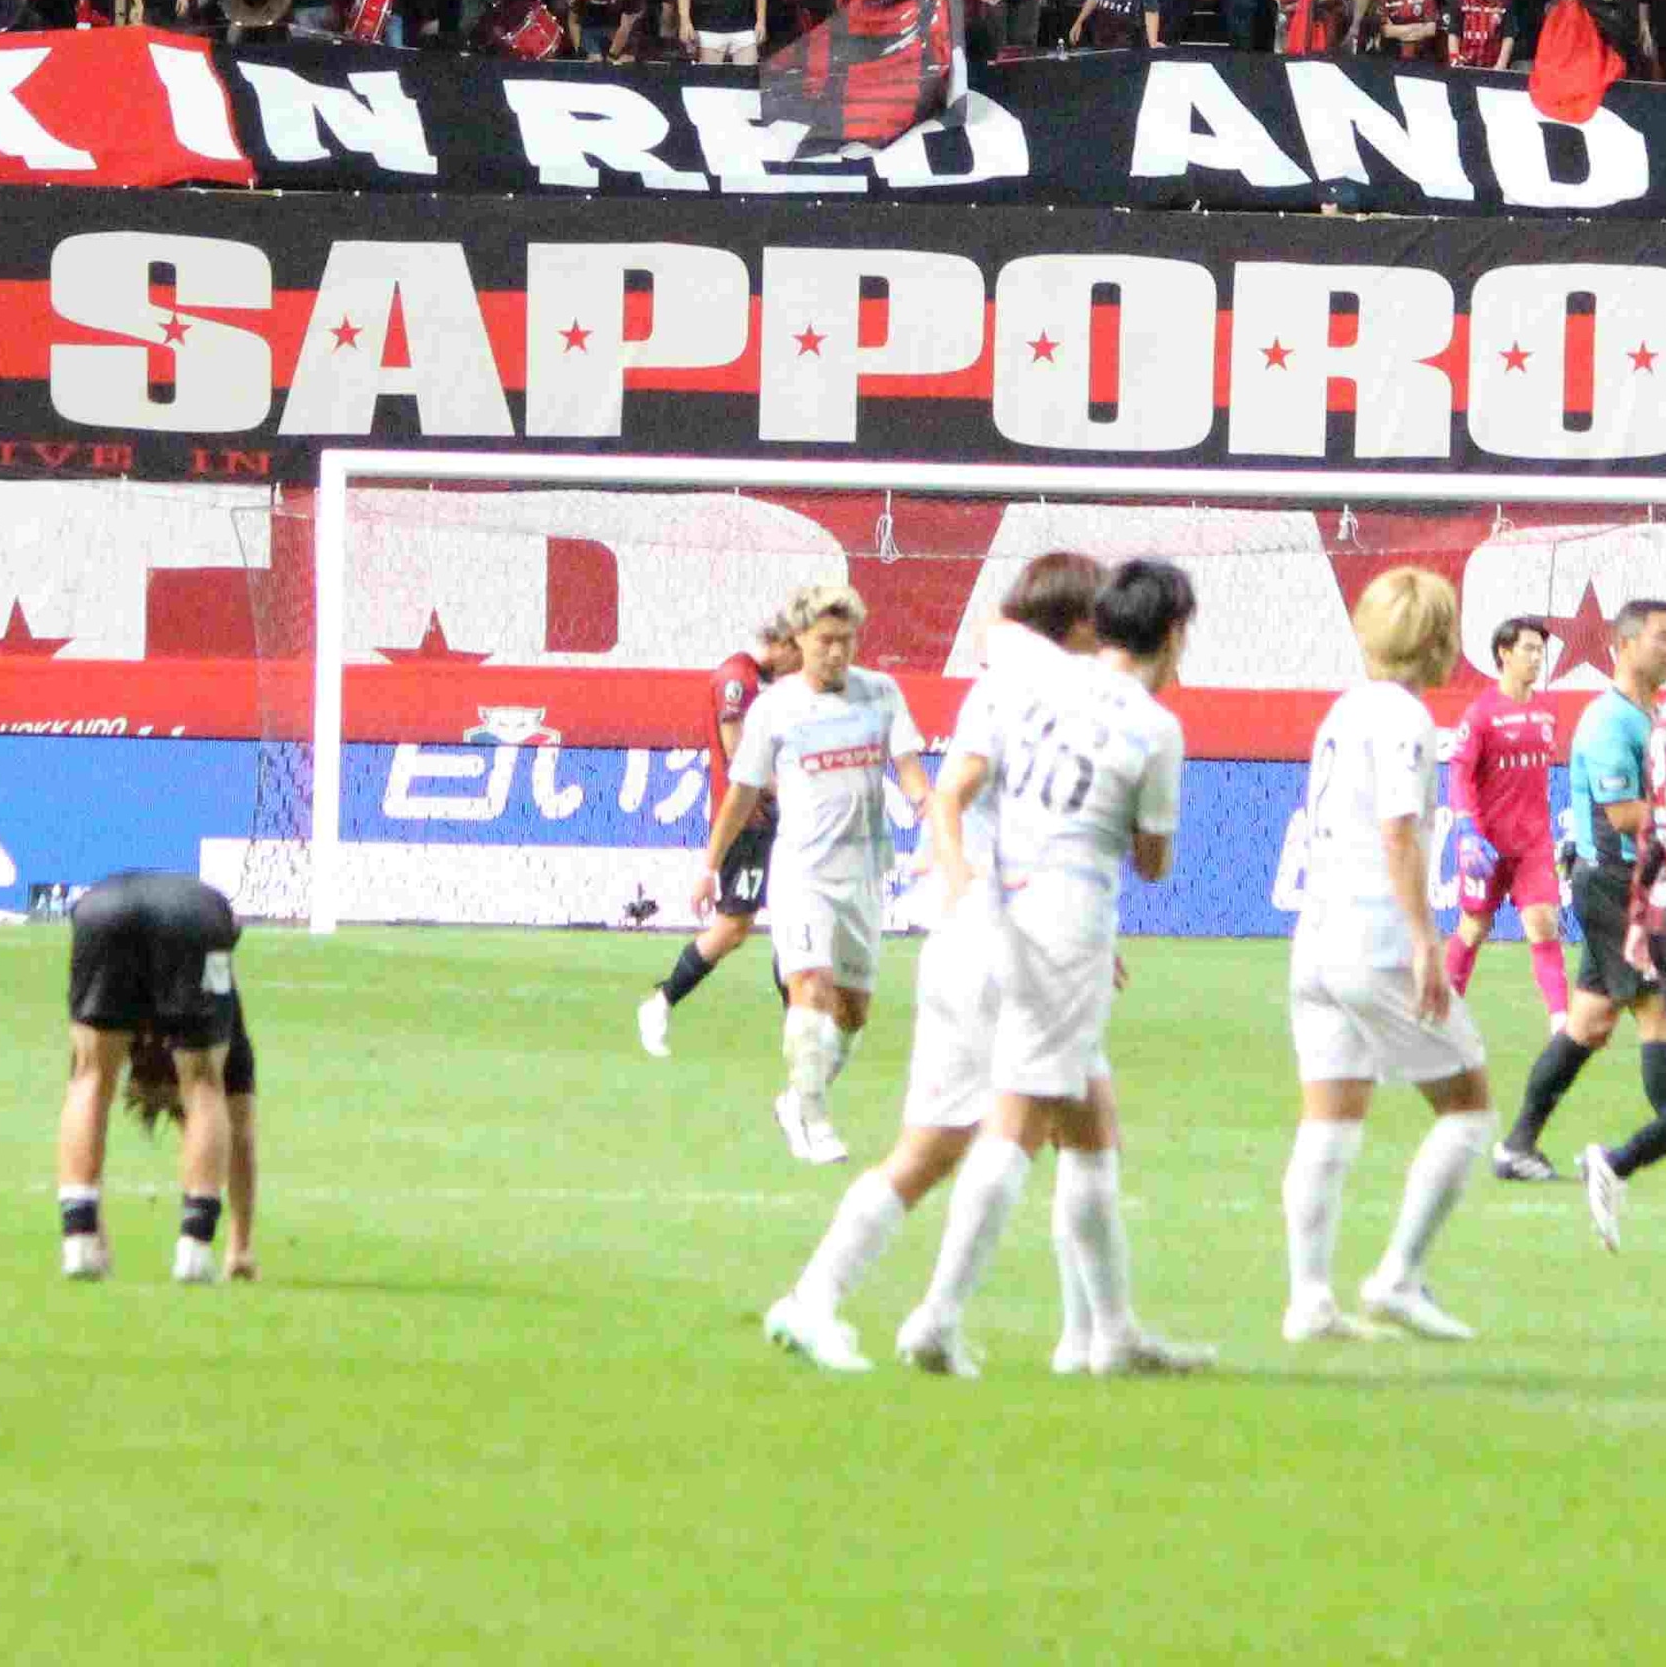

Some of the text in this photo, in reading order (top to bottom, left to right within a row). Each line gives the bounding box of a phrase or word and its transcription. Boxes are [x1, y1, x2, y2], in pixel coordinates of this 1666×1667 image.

[148, 39, 439, 176] IN
[1129, 59, 1651, 209] AND
[191, 448, 272, 478] IN
